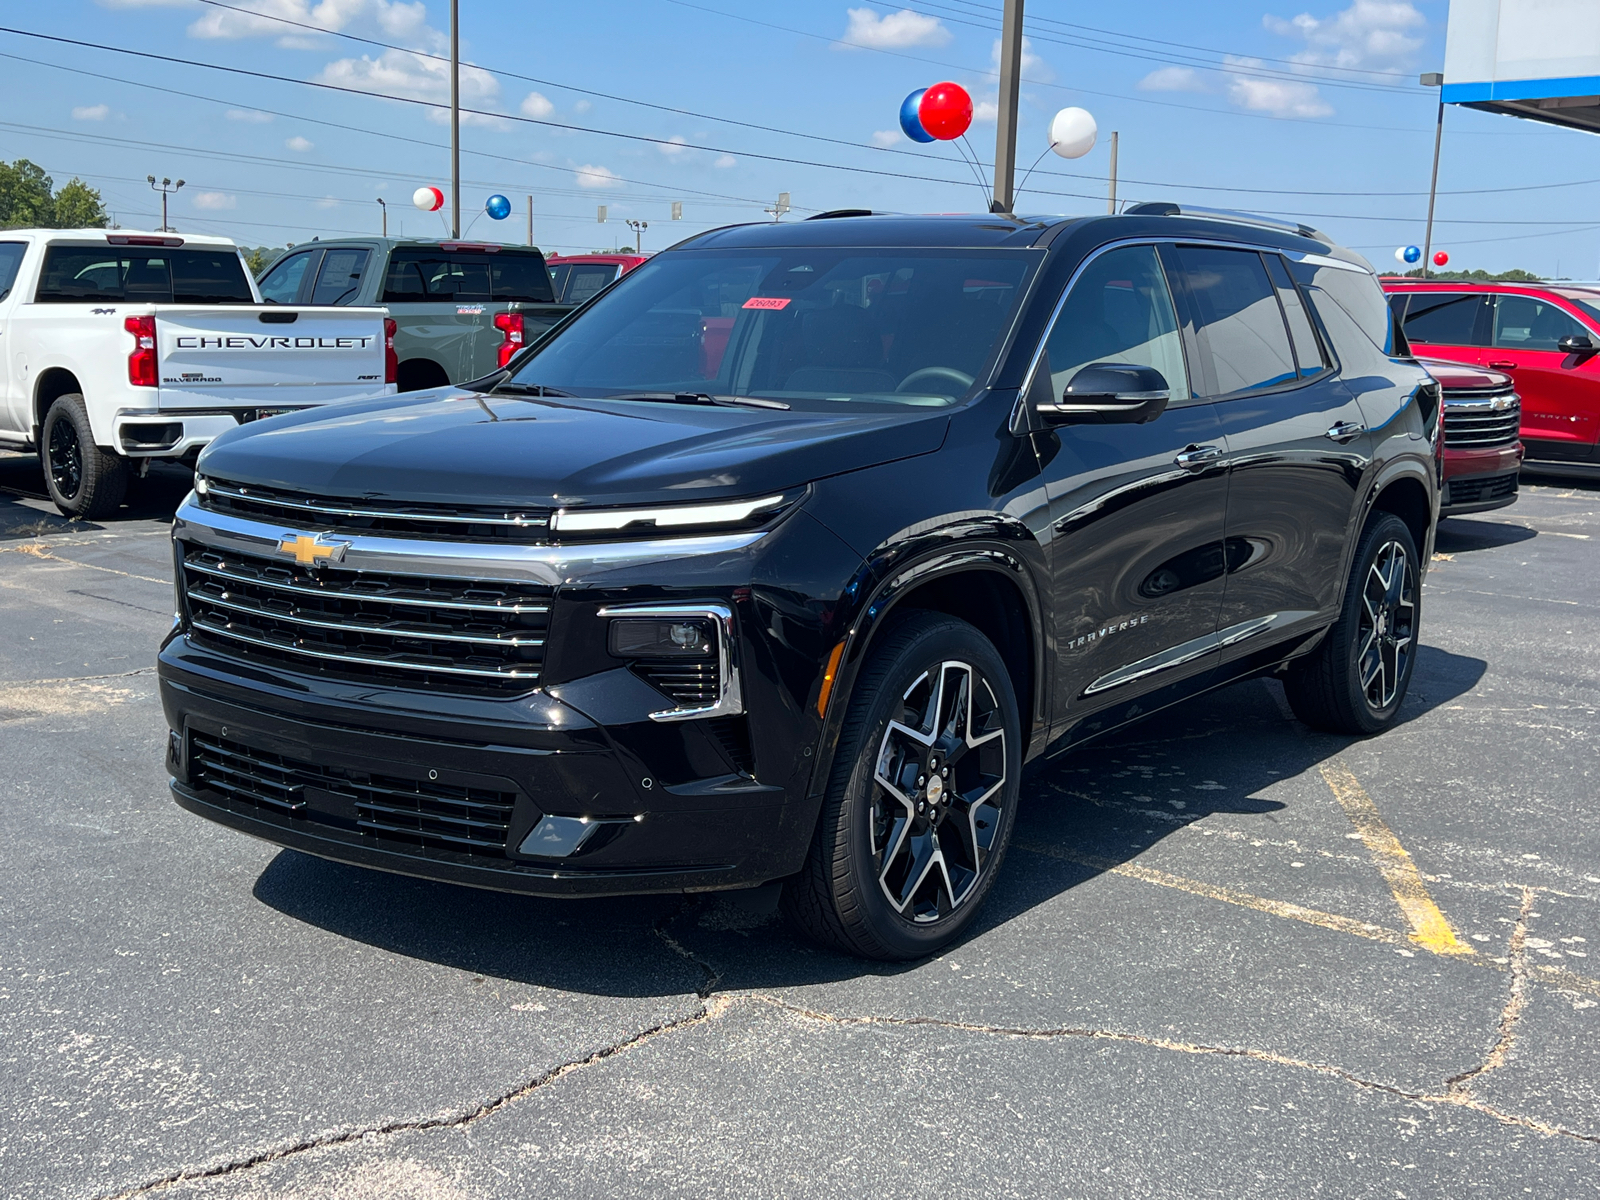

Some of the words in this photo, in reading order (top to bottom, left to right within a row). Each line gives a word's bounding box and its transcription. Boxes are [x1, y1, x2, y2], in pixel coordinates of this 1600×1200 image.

[749, 300, 783, 308] 26093
[177, 337, 372, 349] CHEVROLET
[1067, 615, 1149, 650] TRAVERSE
